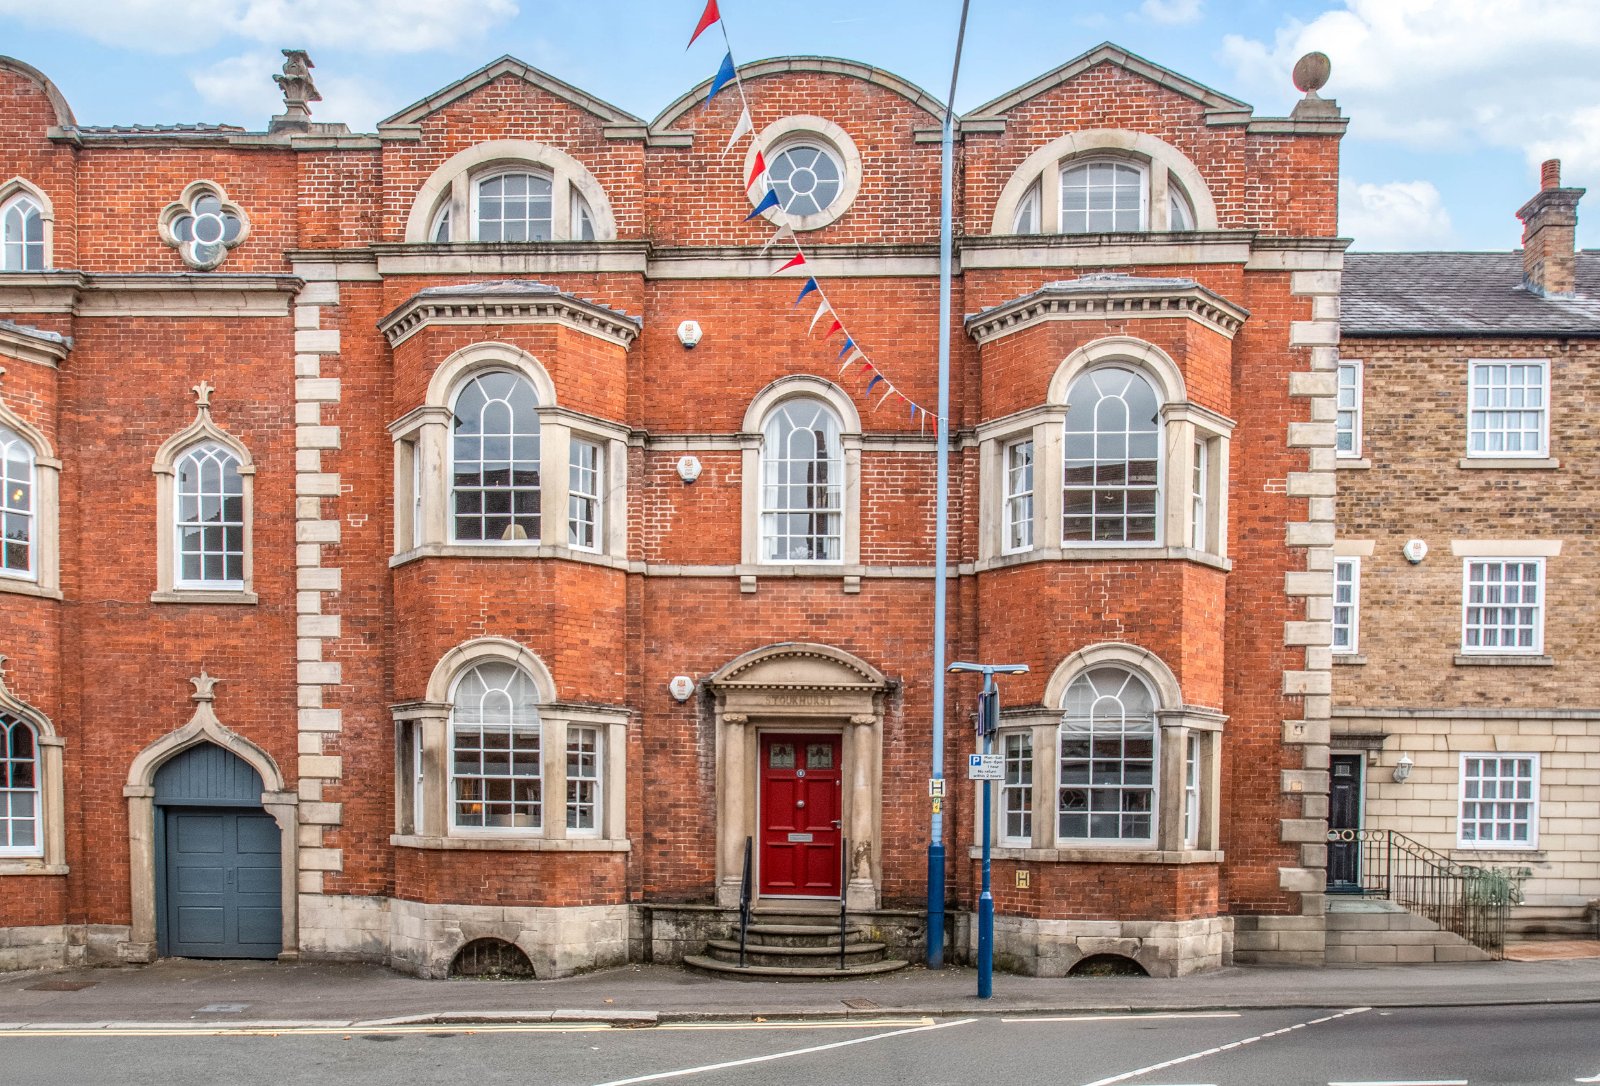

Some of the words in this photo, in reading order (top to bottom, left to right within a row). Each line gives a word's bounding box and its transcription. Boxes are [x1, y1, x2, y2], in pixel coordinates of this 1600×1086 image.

[972, 756, 980, 766] P
[931, 781, 943, 795] H
[1018, 872, 1028, 886] H
